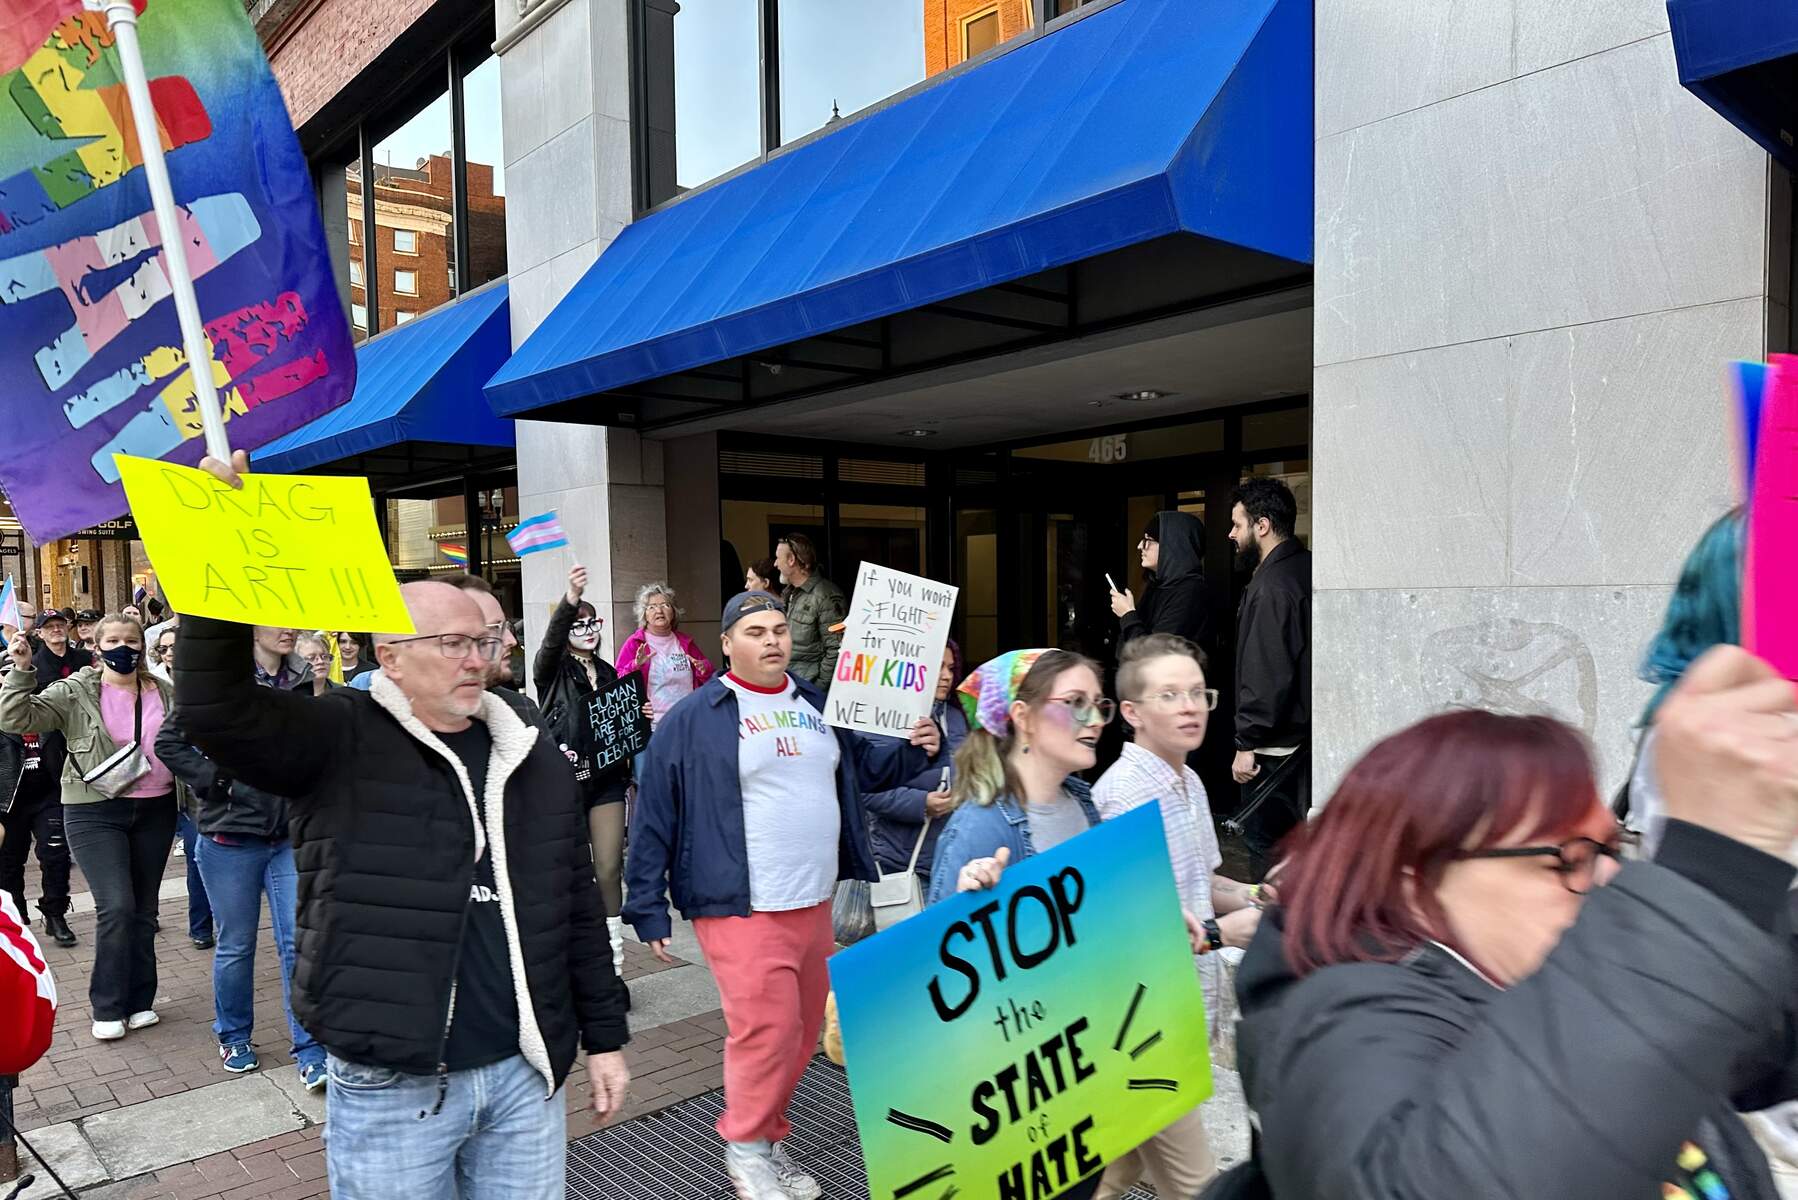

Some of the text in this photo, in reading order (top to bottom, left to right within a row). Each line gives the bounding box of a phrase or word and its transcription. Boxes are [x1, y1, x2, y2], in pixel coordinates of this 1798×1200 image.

[1088, 433, 1127, 463] 465
[161, 468, 335, 524] DRAG
[236, 528, 280, 558] IS
[203, 563, 307, 614] ART
[888, 578, 912, 598] you
[875, 601, 928, 625] FIGHT
[861, 630, 926, 657] for your
[837, 650, 927, 692] GAY KIDS
[588, 679, 637, 715] HUMAN
[589, 693, 640, 729] RIGHTS
[835, 699, 915, 730] WE WILL
[594, 705, 641, 742] ARE NOT
[604, 723, 635, 746] UP FOR
[772, 710, 826, 734] MEANS
[596, 730, 643, 769] DEBATE
[776, 736, 802, 757] ALL
[927, 866, 1085, 1022] STOP
[994, 998, 1046, 1042] the
[970, 1016, 1097, 1146] STATE
[1027, 1112, 1049, 1143] of
[998, 1114, 1103, 1200] HATE
